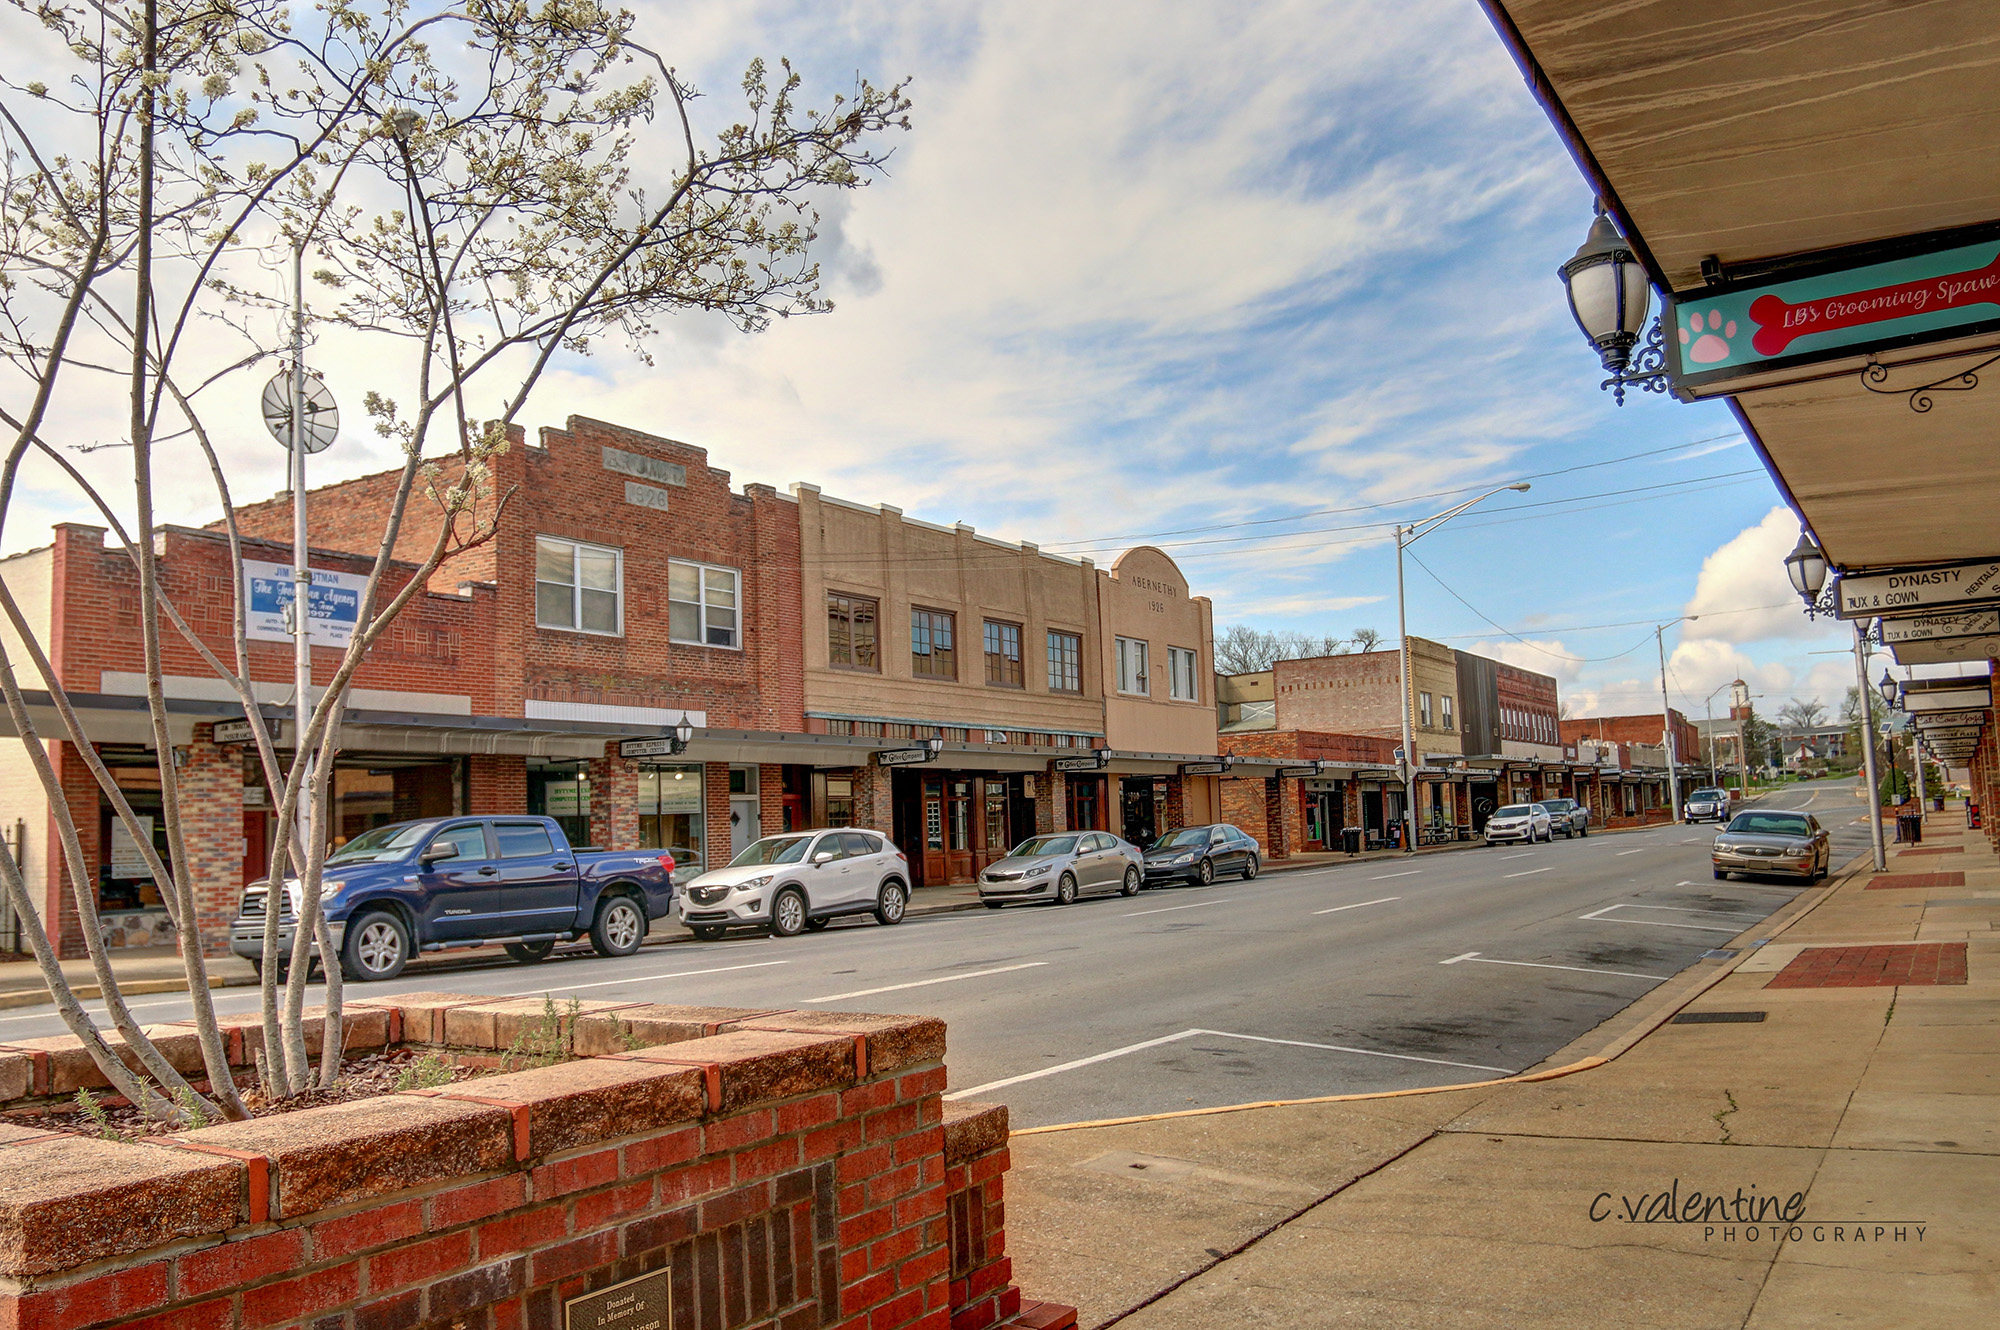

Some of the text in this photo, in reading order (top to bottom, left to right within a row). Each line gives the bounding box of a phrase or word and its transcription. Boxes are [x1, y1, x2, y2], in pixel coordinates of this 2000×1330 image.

[1783, 305, 1820, 328] LB's
[1825, 289, 1932, 320] Grooming
[275, 567, 289, 577] JIM
[1889, 570, 1961, 588] DYNASTY
[1965, 565, 1999, 596] RENTALS
[253, 579, 272, 594] The
[324, 589, 356, 607] Agency
[1131, 576, 1177, 597] ABERNETHY
[1148, 601, 1164, 613] 1926
[1847, 591, 1919, 609] TUX & GOWN
[1913, 616, 1960, 628] DYNASTY
[1978, 615, 1997, 632] SALE
[1887, 632, 1900, 640] TUX
[1911, 629, 1933, 638] GOWN
[606, 1293, 635, 1311] Donated
[597, 1301, 645, 1326] In Memory Of
